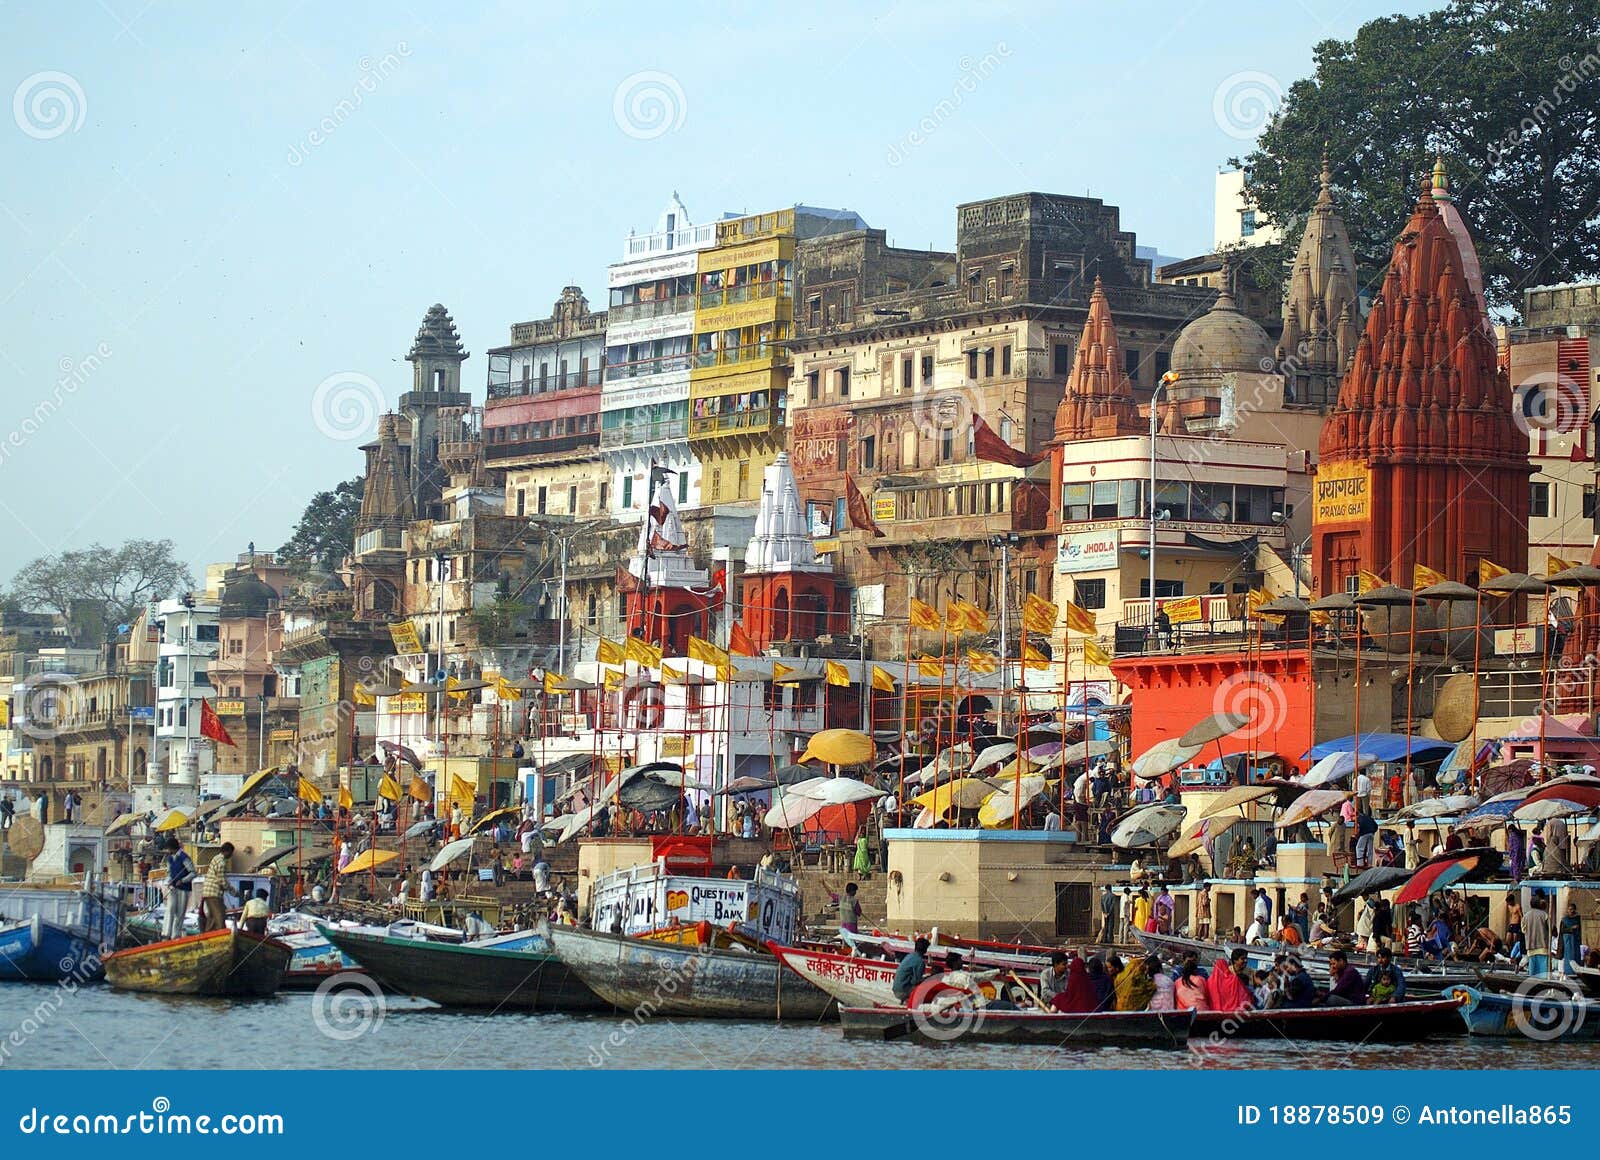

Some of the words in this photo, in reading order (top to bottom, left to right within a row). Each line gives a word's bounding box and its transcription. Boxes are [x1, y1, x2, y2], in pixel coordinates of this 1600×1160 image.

[1319, 505, 1346, 518] PRAYAG
[1347, 502, 1366, 515] GHAT
[1084, 541, 1115, 554] JHOOLA
[714, 901, 743, 920] BANK
